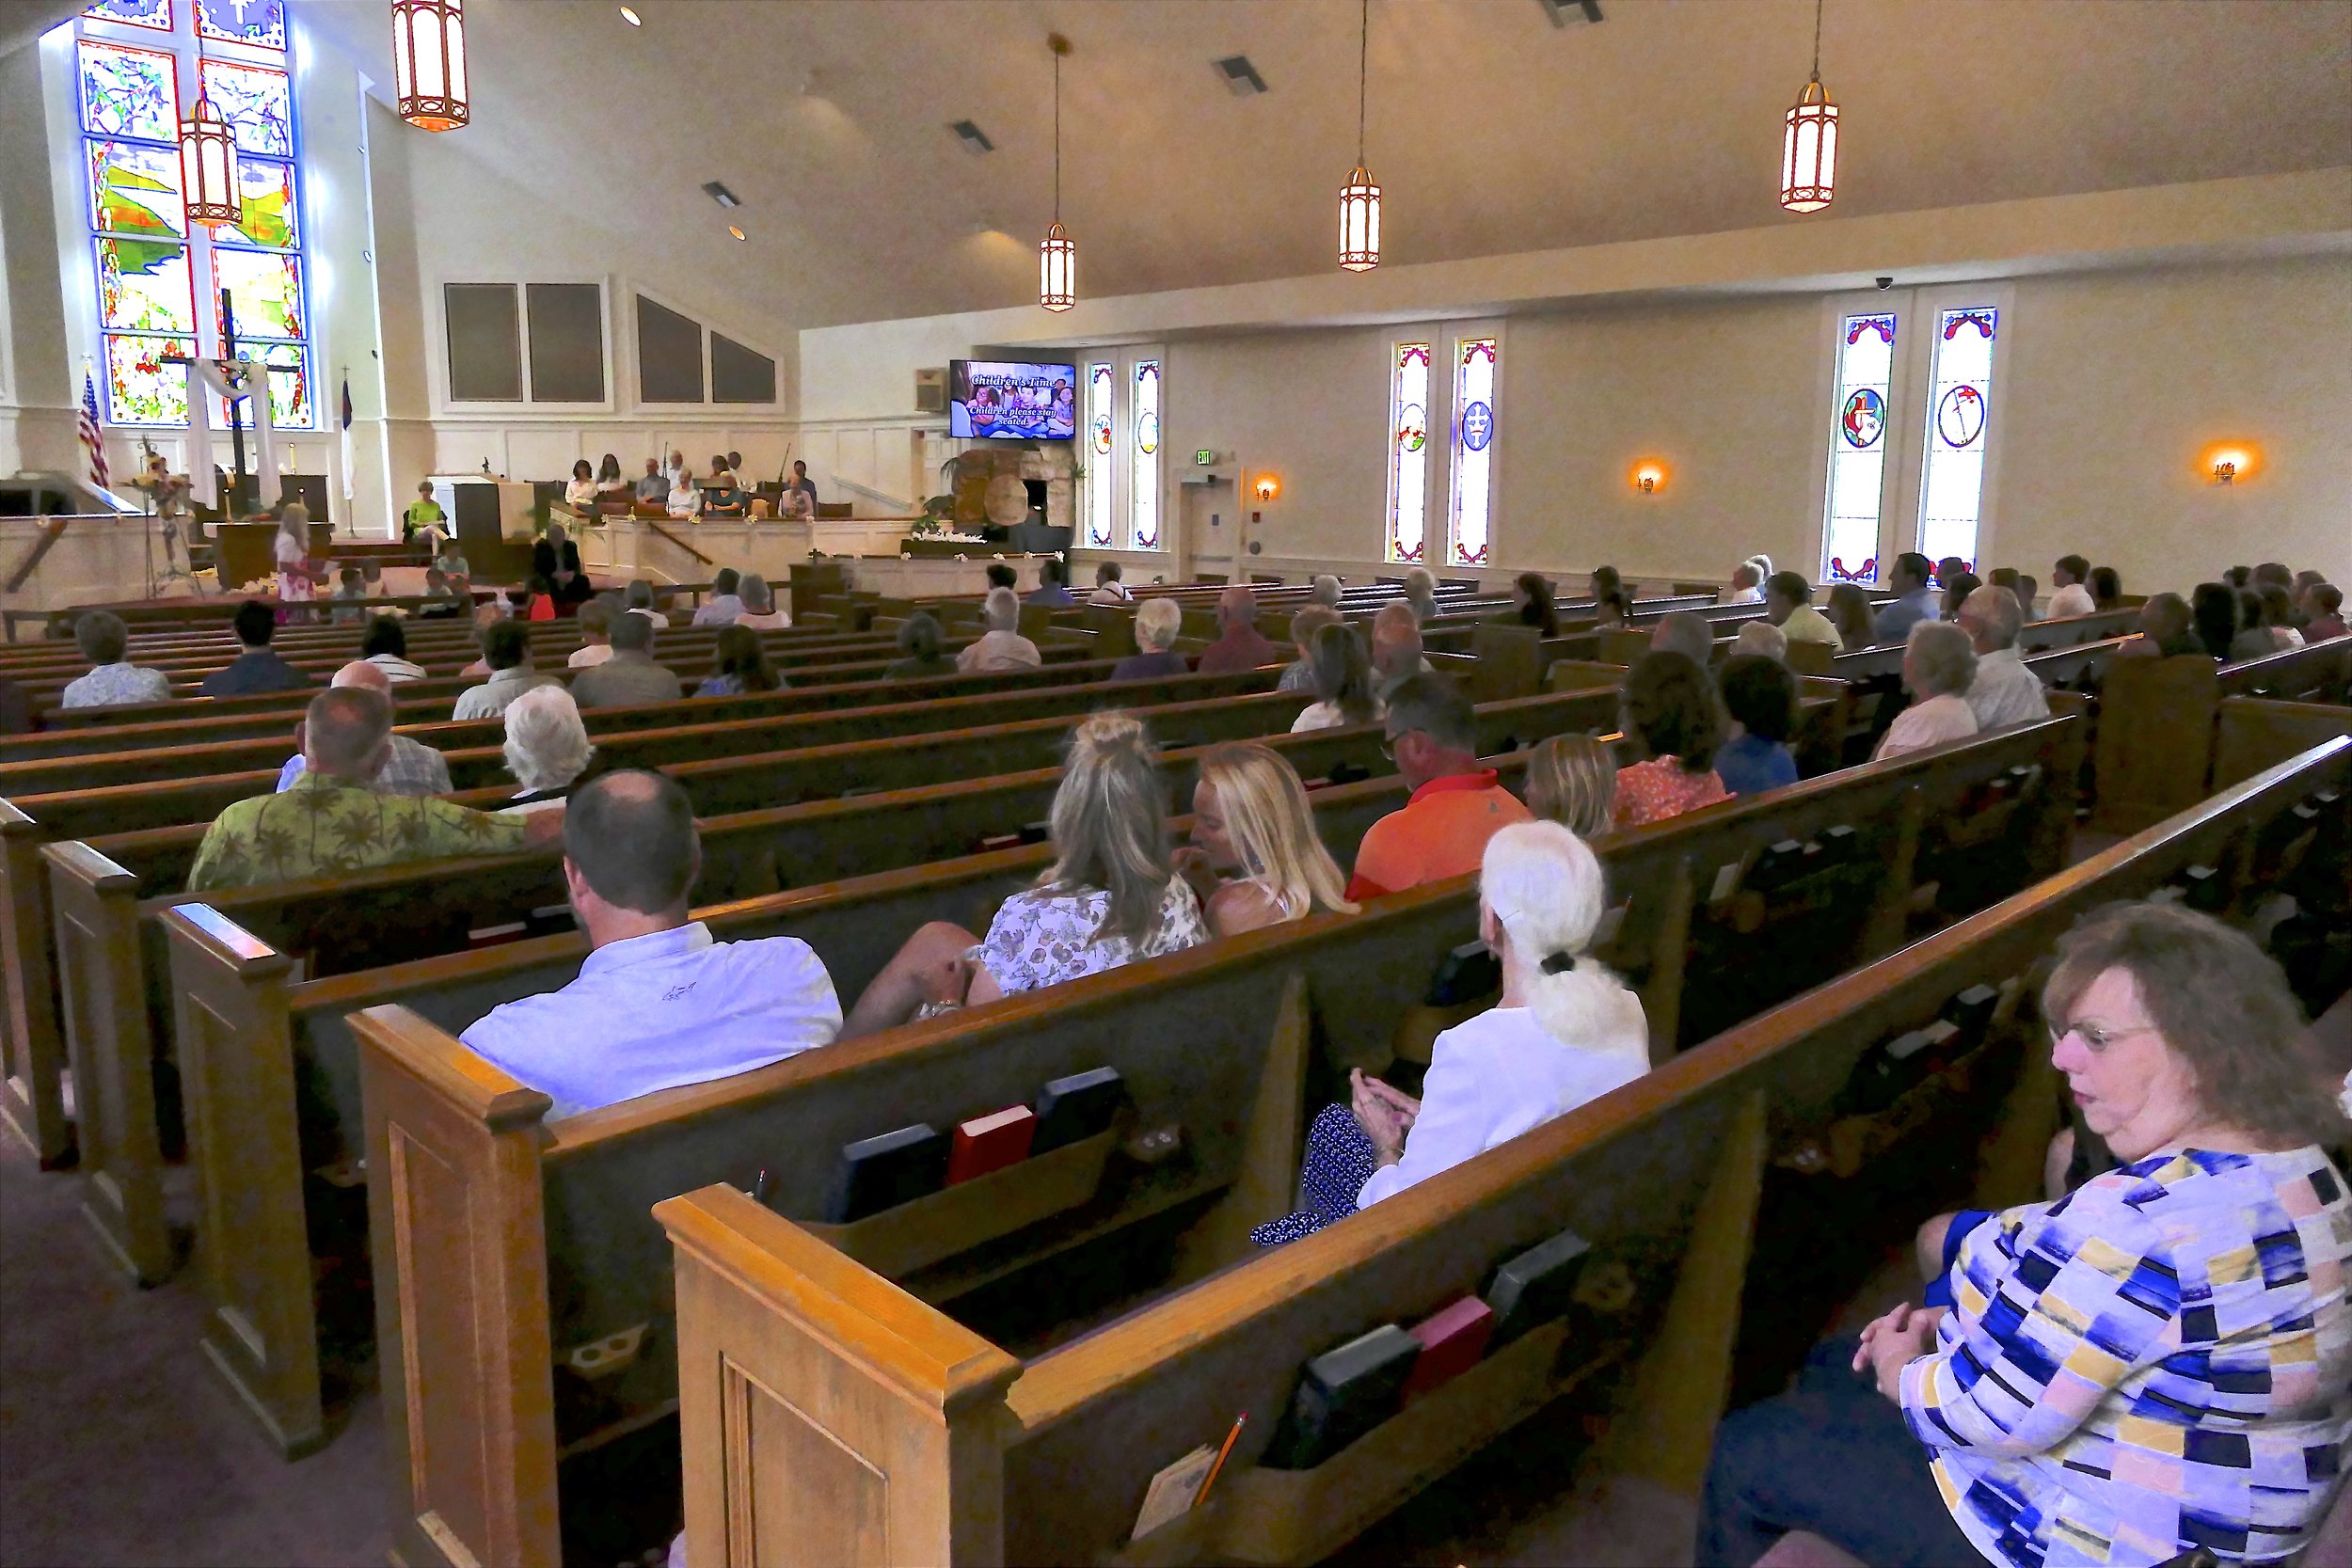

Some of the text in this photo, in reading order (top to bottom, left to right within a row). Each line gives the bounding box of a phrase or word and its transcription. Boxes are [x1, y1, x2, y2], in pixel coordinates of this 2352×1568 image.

[971, 375, 1056, 387] Children's Time
[970, 406, 1057, 419] Children please stay
